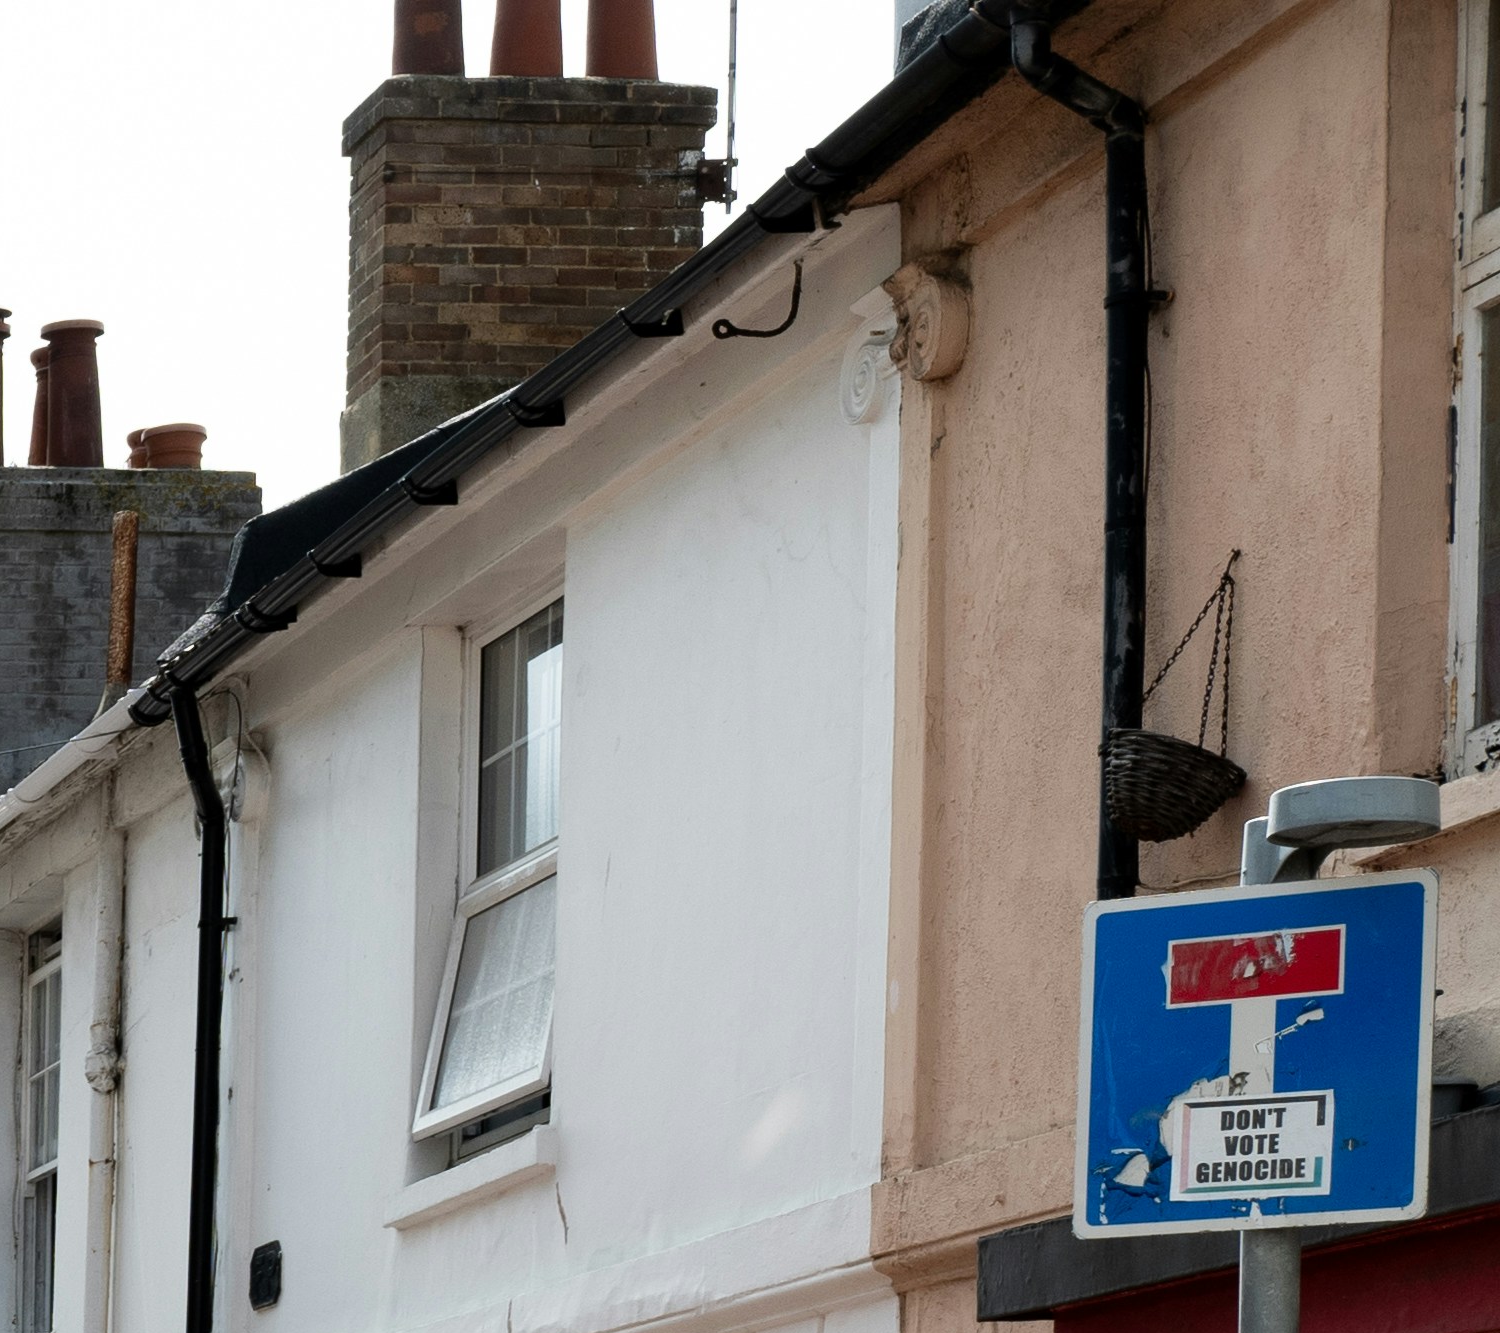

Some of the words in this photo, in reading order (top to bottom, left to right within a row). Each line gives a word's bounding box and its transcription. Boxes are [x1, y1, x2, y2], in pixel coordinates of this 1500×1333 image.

[1220, 1107, 1287, 1131] DON'T
[1224, 1134, 1280, 1157] VOTE
[1195, 1157, 1306, 1184] GENOCIDE
